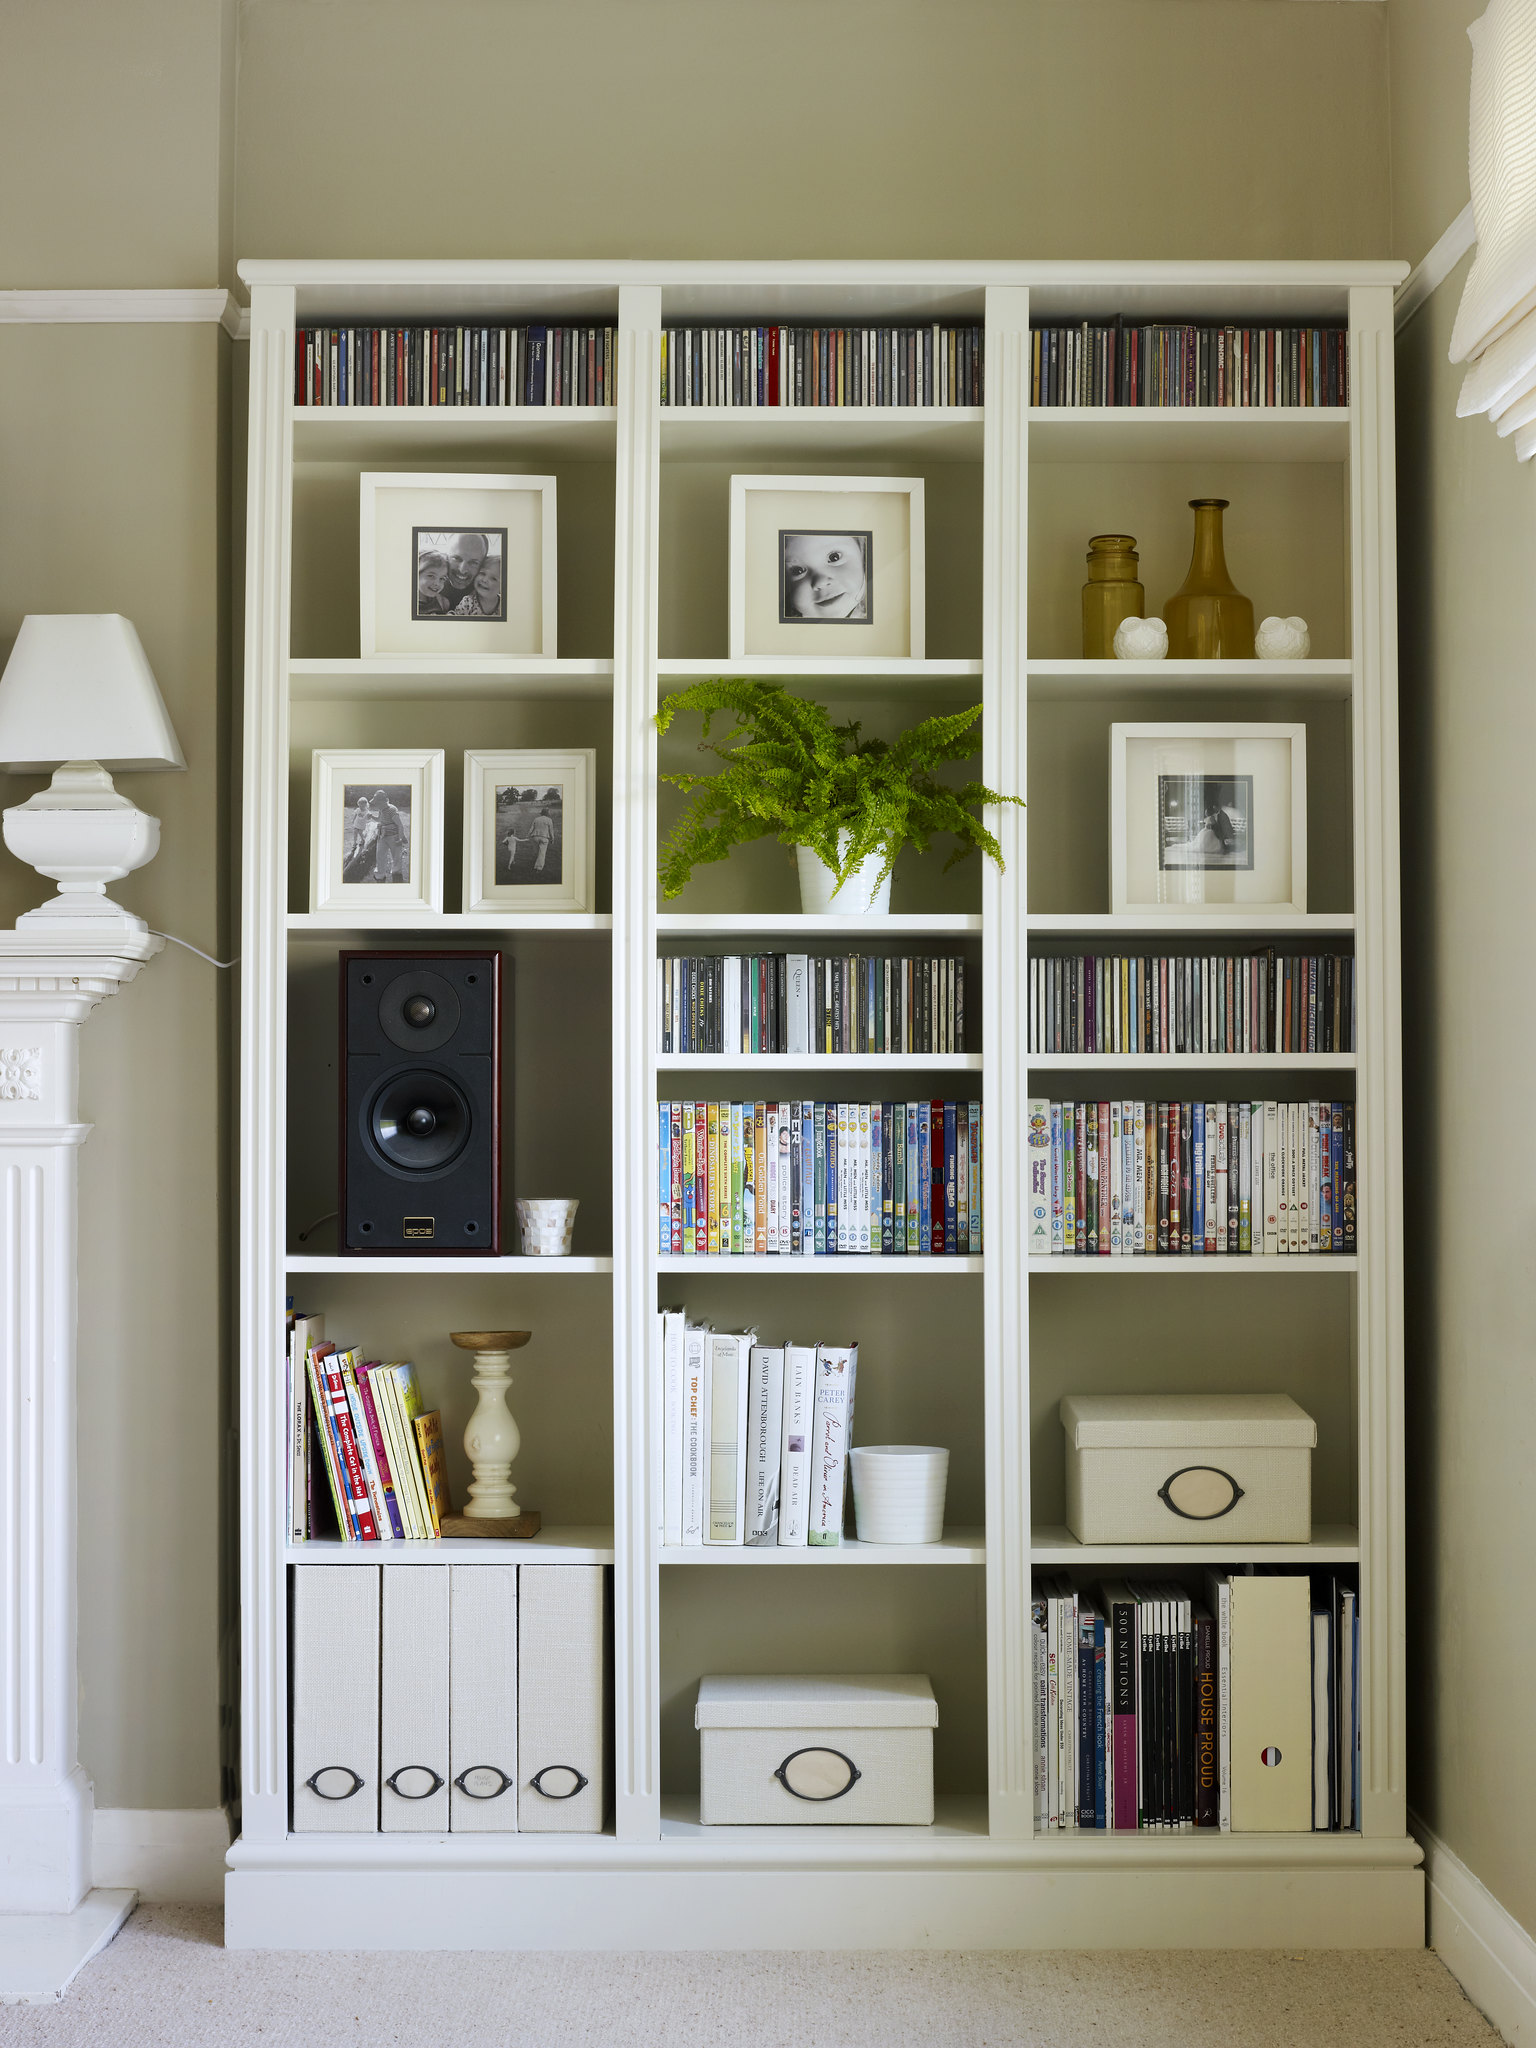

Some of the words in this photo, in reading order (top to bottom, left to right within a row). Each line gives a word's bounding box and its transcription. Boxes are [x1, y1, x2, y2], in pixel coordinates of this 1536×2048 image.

[1195, 1155, 1203, 1175] train
[761, 1356, 770, 1385] DAVID
[794, 1365, 802, 1388] IAIN
[690, 1376, 698, 1393] TOP
[820, 1389, 845, 1397] PETER
[793, 1392, 802, 1425] BANKS
[817, 1396, 845, 1404] CAREY
[339, 1415, 348, 1427] The
[759, 1387, 769, 1463] ATTENBOROUGH
[342, 1428, 353, 1455] Complete
[824, 1442, 832, 1456] and
[689, 1437, 697, 1477] COOKBOOK
[355, 1486, 363, 1497] Hat
[758, 1488, 765, 1501] ON
[821, 1493, 831, 1526] America
[1119, 1610, 1128, 1634] 500
[1096, 1669, 1104, 1694] creating
[1119, 1640, 1128, 1706] NATIONS
[1201, 1672, 1213, 1725] HOUSE
[1201, 1732, 1213, 1788] PROUD
